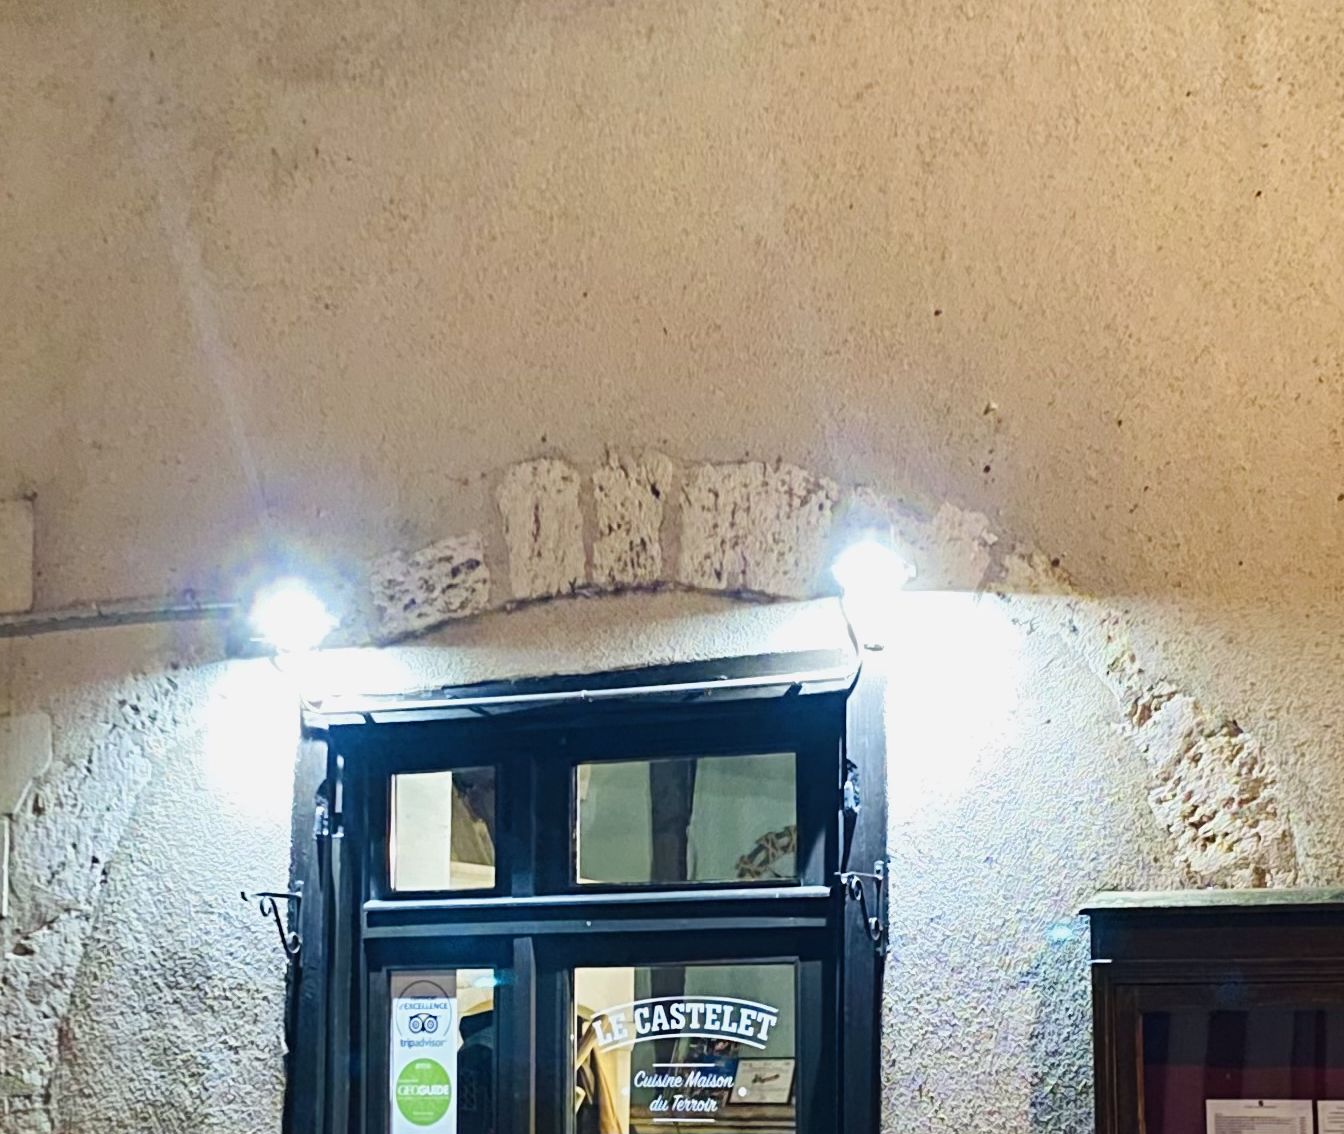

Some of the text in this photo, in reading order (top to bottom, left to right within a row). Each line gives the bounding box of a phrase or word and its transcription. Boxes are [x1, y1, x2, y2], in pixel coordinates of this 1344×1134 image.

[592, 1002, 778, 1047] LE CASTELET
[400, 1038, 444, 1049] tripadvisor
[633, 1070, 683, 1090] Cuisine
[684, 1071, 734, 1089] Maison
[649, 1095, 718, 1113] du Terroir
